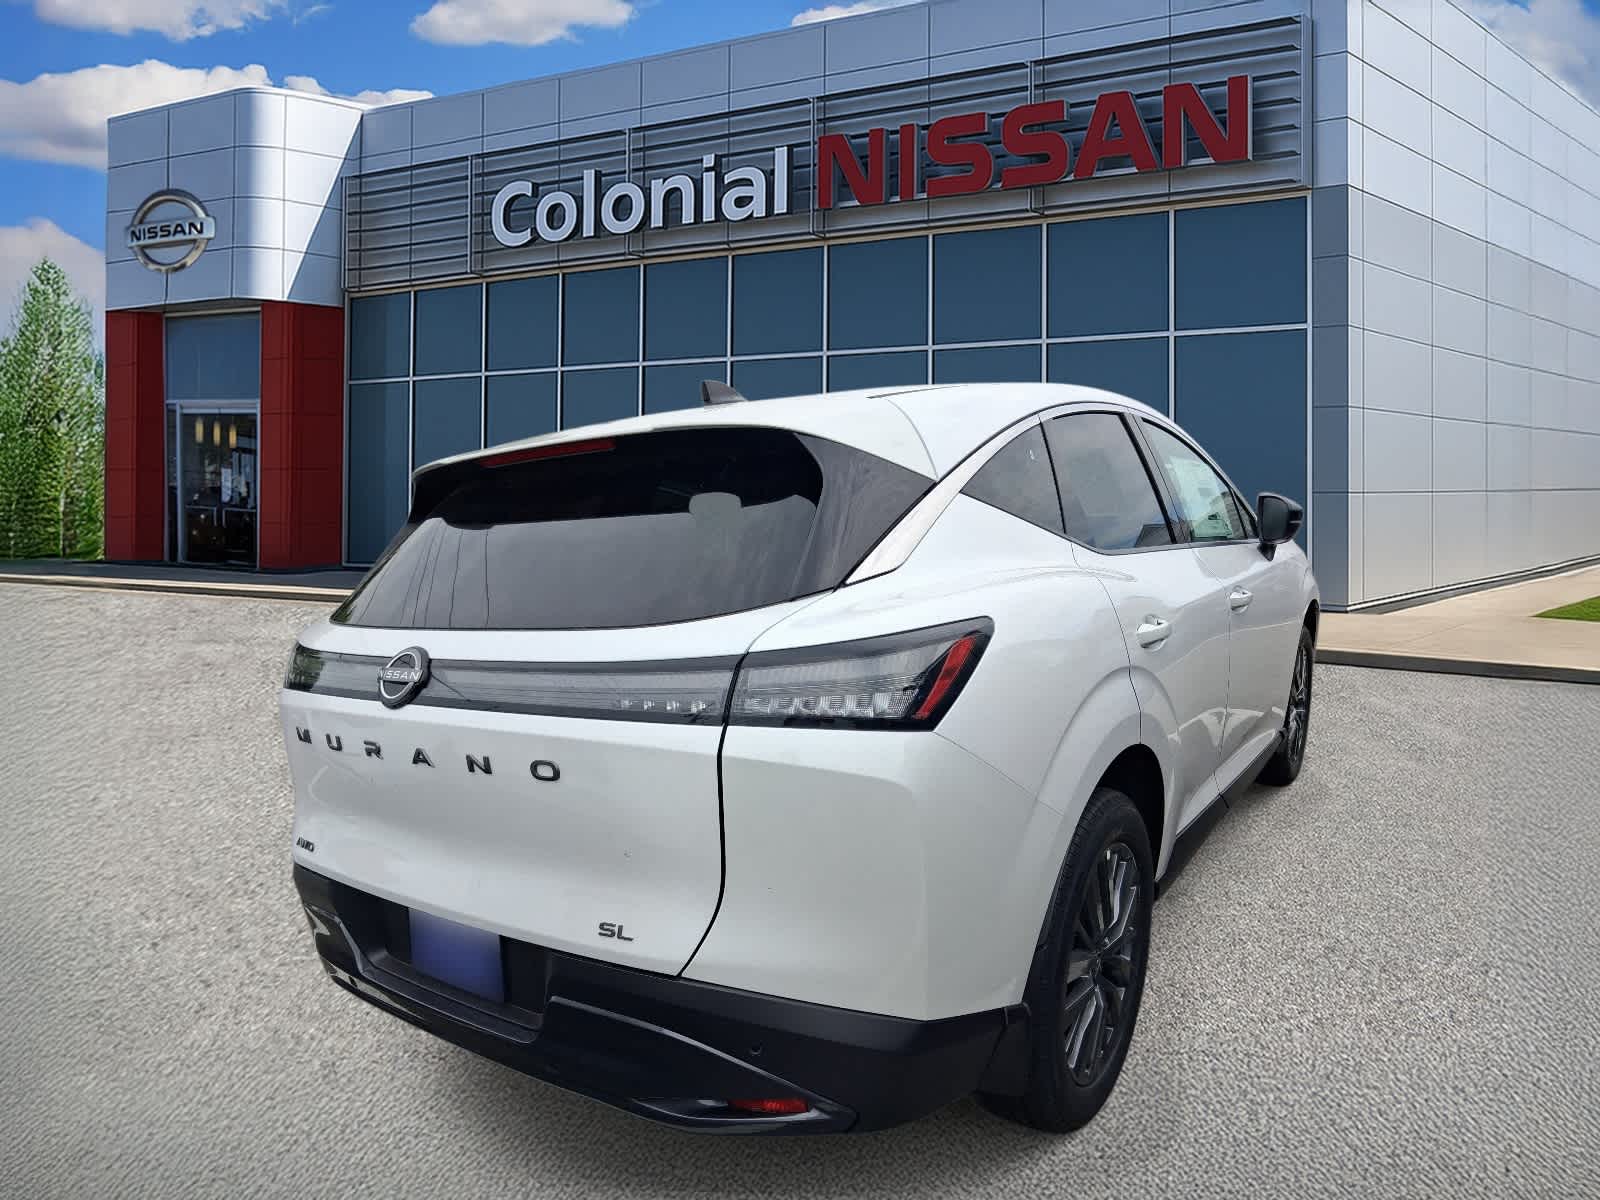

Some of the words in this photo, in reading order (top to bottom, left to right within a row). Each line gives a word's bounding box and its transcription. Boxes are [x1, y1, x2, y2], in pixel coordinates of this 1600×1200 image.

[491, 146, 790, 247] Colonial
[818, 75, 1253, 209] NISSAN
[130, 220, 204, 242] NISSAN
[378, 668, 420, 681] NISSAN
[296, 726, 561, 782] MURANO
[296, 836, 314, 852] AWD
[598, 922, 634, 941] SL
